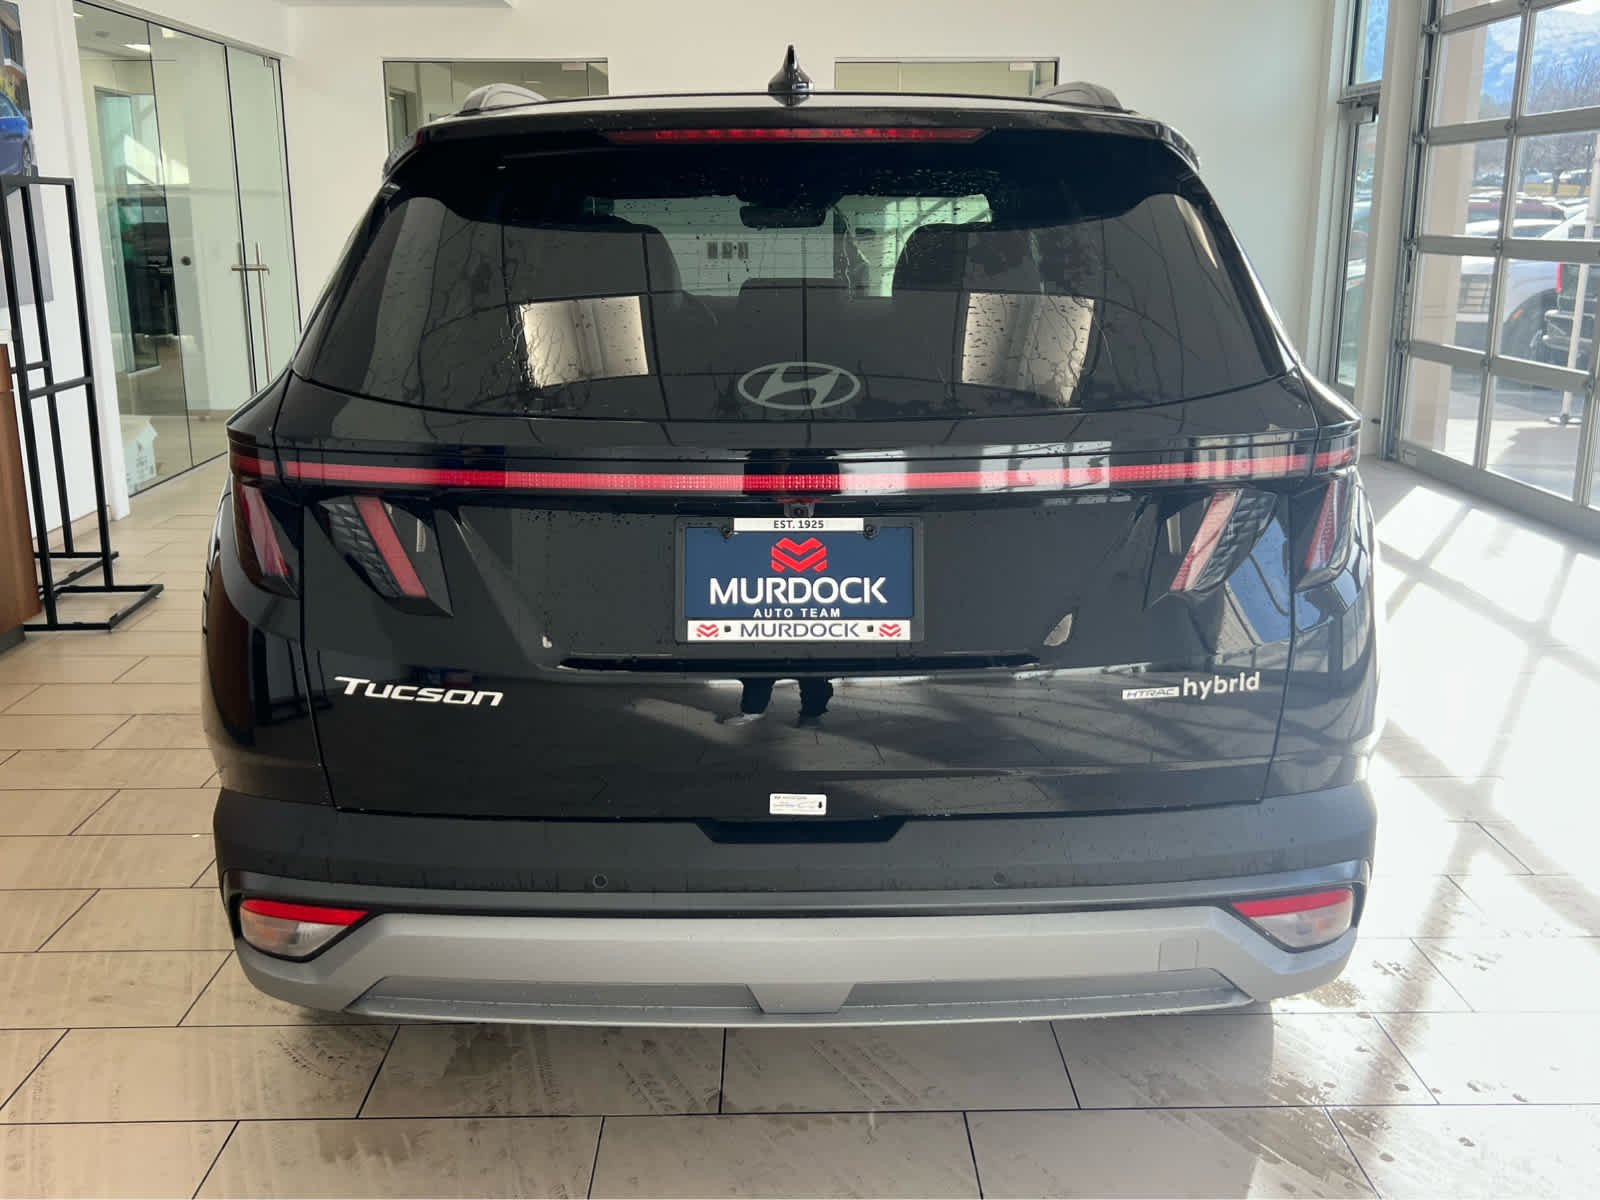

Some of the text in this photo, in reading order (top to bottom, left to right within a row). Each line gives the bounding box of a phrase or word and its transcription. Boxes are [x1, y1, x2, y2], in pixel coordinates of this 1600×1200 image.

[773, 519, 825, 529] EST. 1925
[709, 576, 888, 605] MURDOCK
[753, 607, 841, 618] AUTO TEAM
[740, 623, 860, 638] MURDOCK
[1125, 671, 1260, 700] HTRAC hybrid
